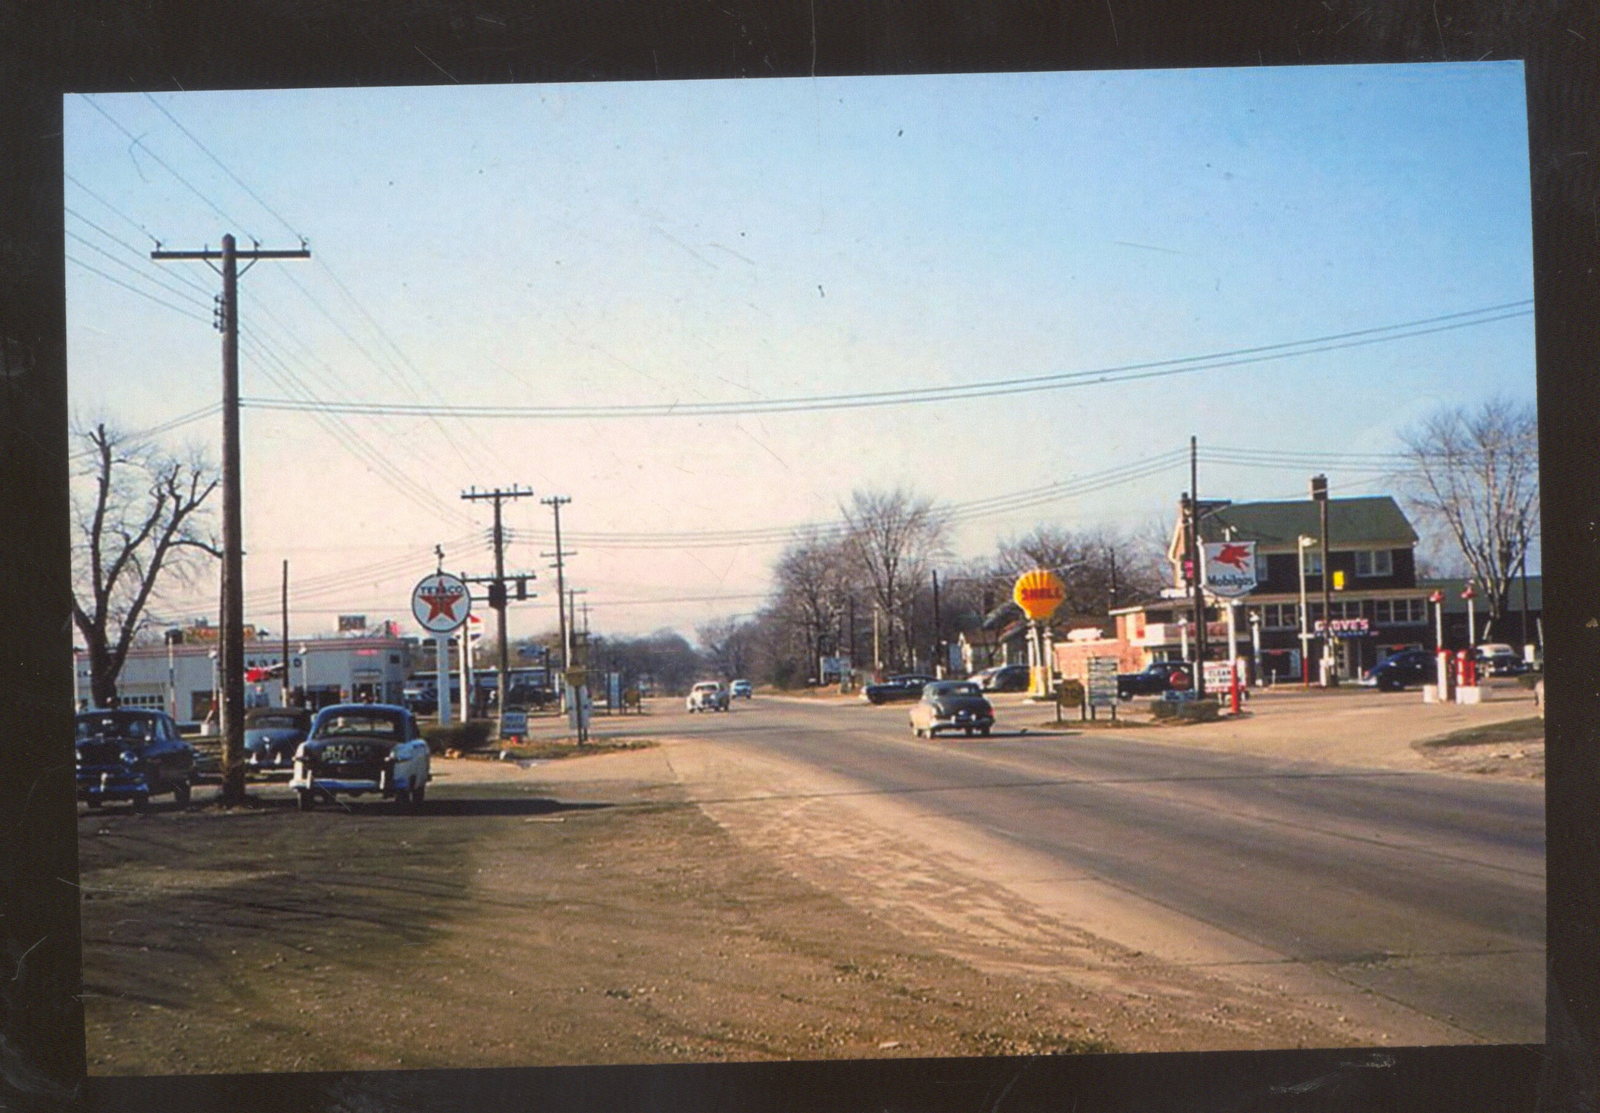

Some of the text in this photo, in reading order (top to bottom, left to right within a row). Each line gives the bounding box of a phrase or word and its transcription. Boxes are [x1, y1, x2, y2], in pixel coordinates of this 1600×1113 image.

[1207, 574, 1255, 589] Mobilgas
[420, 585, 464, 595] TEXACO
[1020, 587, 1061, 600] SHELL
